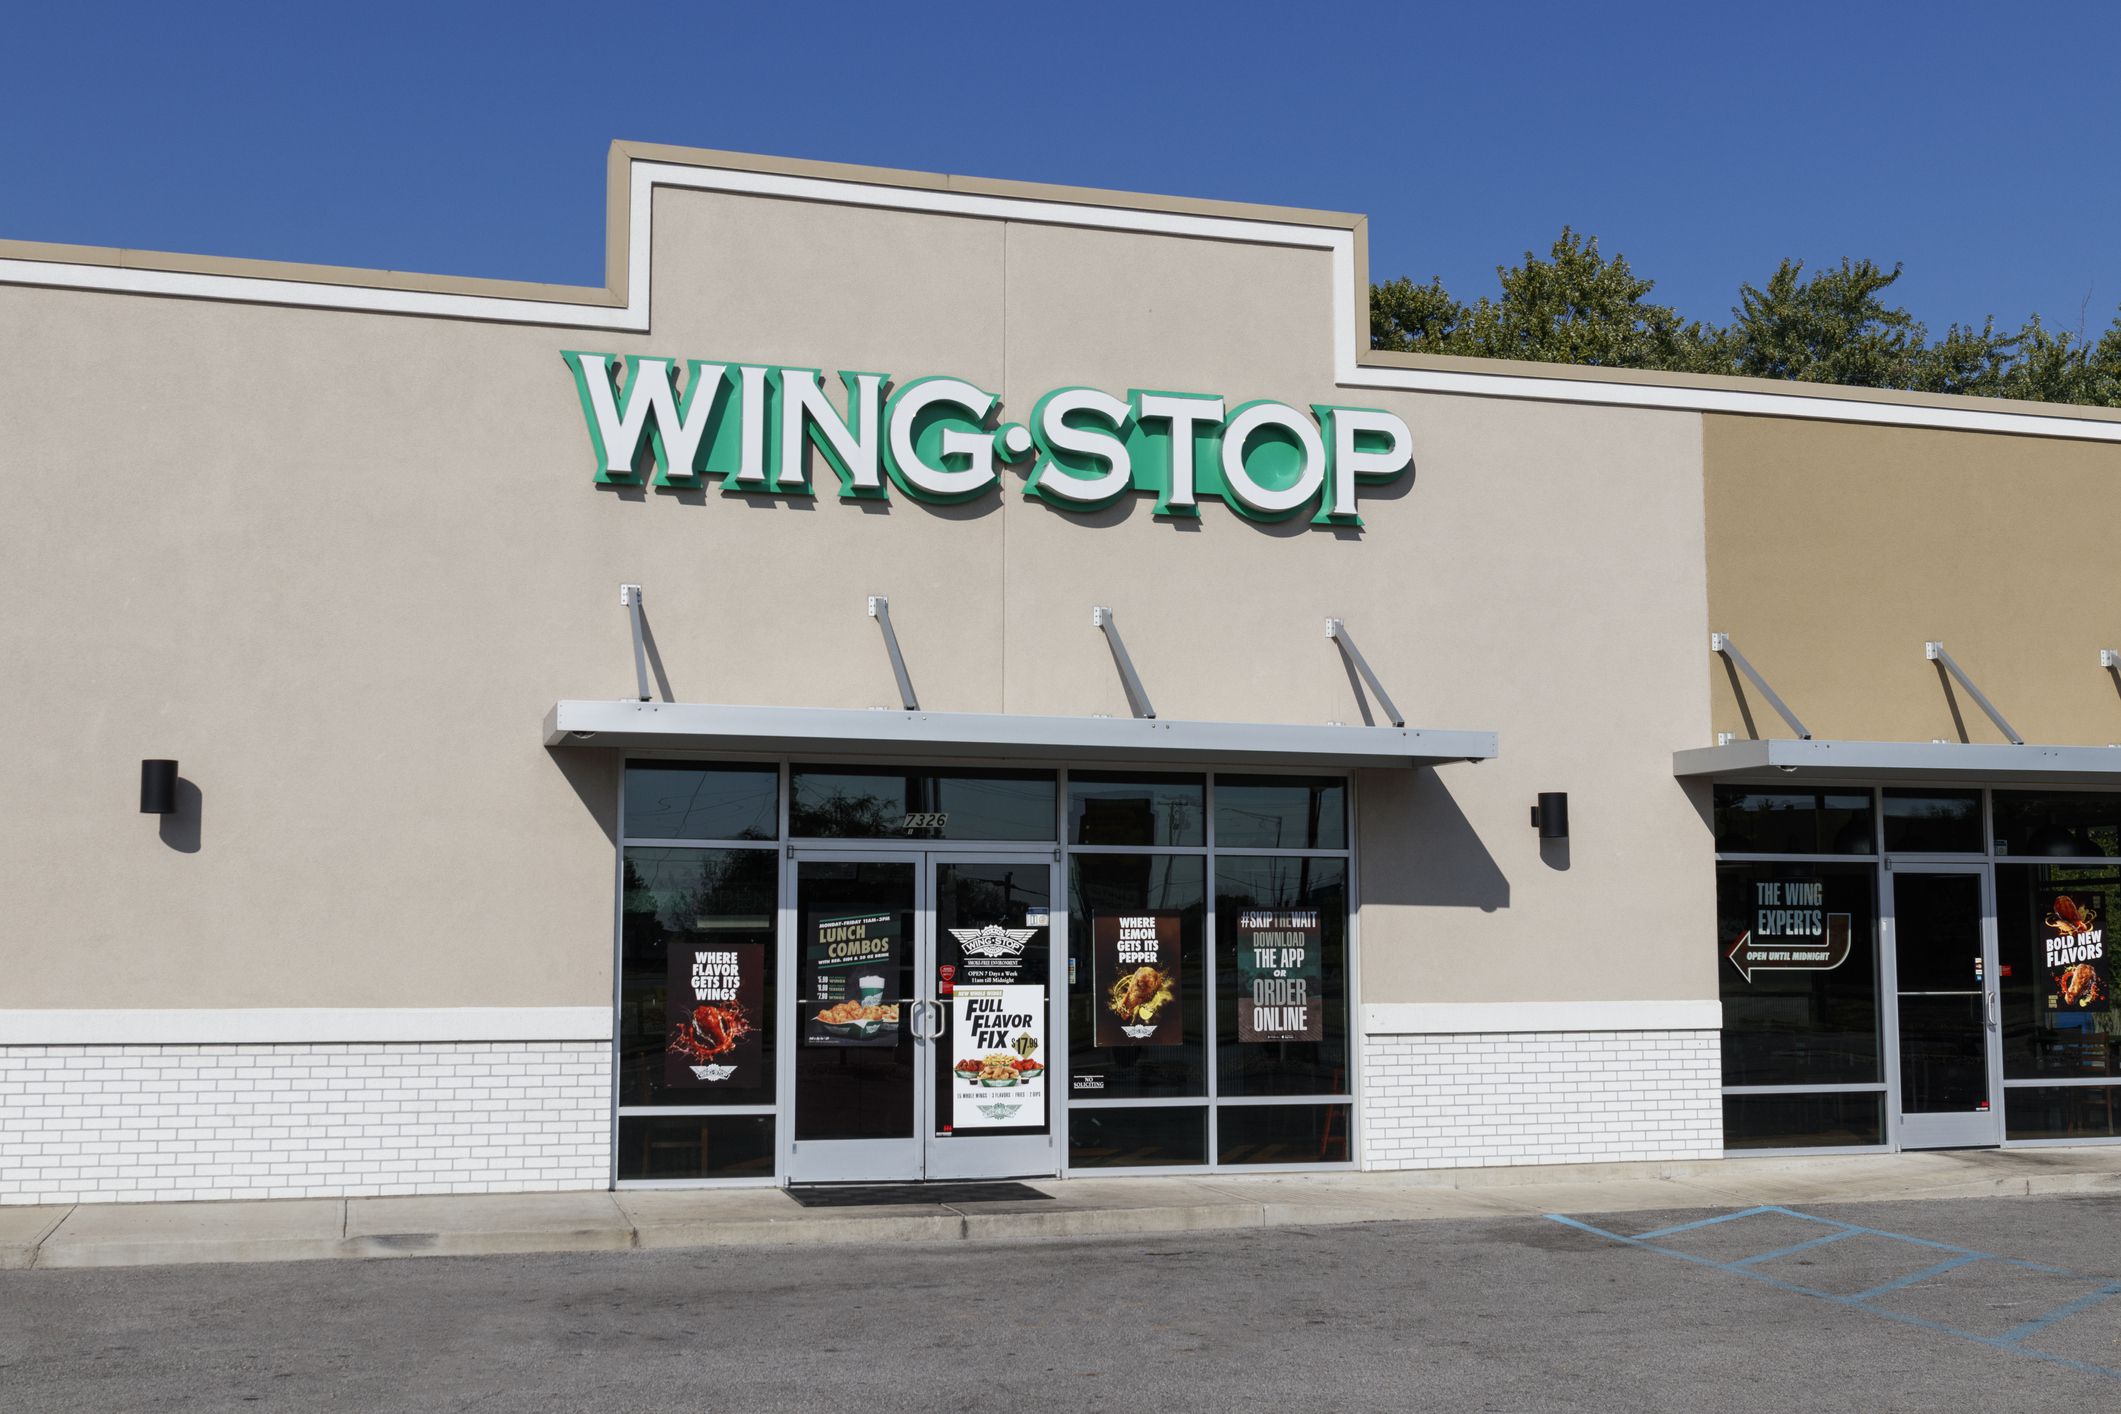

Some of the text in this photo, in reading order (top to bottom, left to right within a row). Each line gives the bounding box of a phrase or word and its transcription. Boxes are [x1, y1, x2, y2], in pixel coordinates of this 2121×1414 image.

[906, 814, 946, 827] 7326
[1757, 882, 1822, 906] THE WING
[1119, 917, 1156, 928] WHERE
[1758, 909, 1822, 936] EXPERTS
[819, 924, 866, 944] LUNCH
[1119, 929, 1156, 940] LEMON
[1253, 931, 1305, 947] DOWNLOAD
[2046, 929, 2102, 952] BOLD NEW
[828, 937, 889, 958] COMBOS
[1116, 940, 1159, 952] GETS ITS
[695, 952, 738, 964] WHERE
[1118, 952, 1158, 963] PEPPER
[1253, 948, 1305, 968] THE APP
[1746, 951, 1830, 961] OPEN UNTIL MIDNIGHT
[2046, 943, 2103, 968] FLAVORS
[692, 964, 739, 976] FLAVOR
[988, 970, 1001, 978] Days
[1273, 969, 1287, 977] OR
[691, 976, 740, 989] GETS ITS
[992, 977, 1015, 985] Midnight
[695, 988, 737, 1001] WINGS
[1253, 978, 1307, 1006] ORDER
[965, 998, 1004, 1021] FULL
[971, 1014, 1033, 1037] FLAVOR
[1253, 1006, 1308, 1031] ONLINE
[977, 1030, 1010, 1049] FIX
